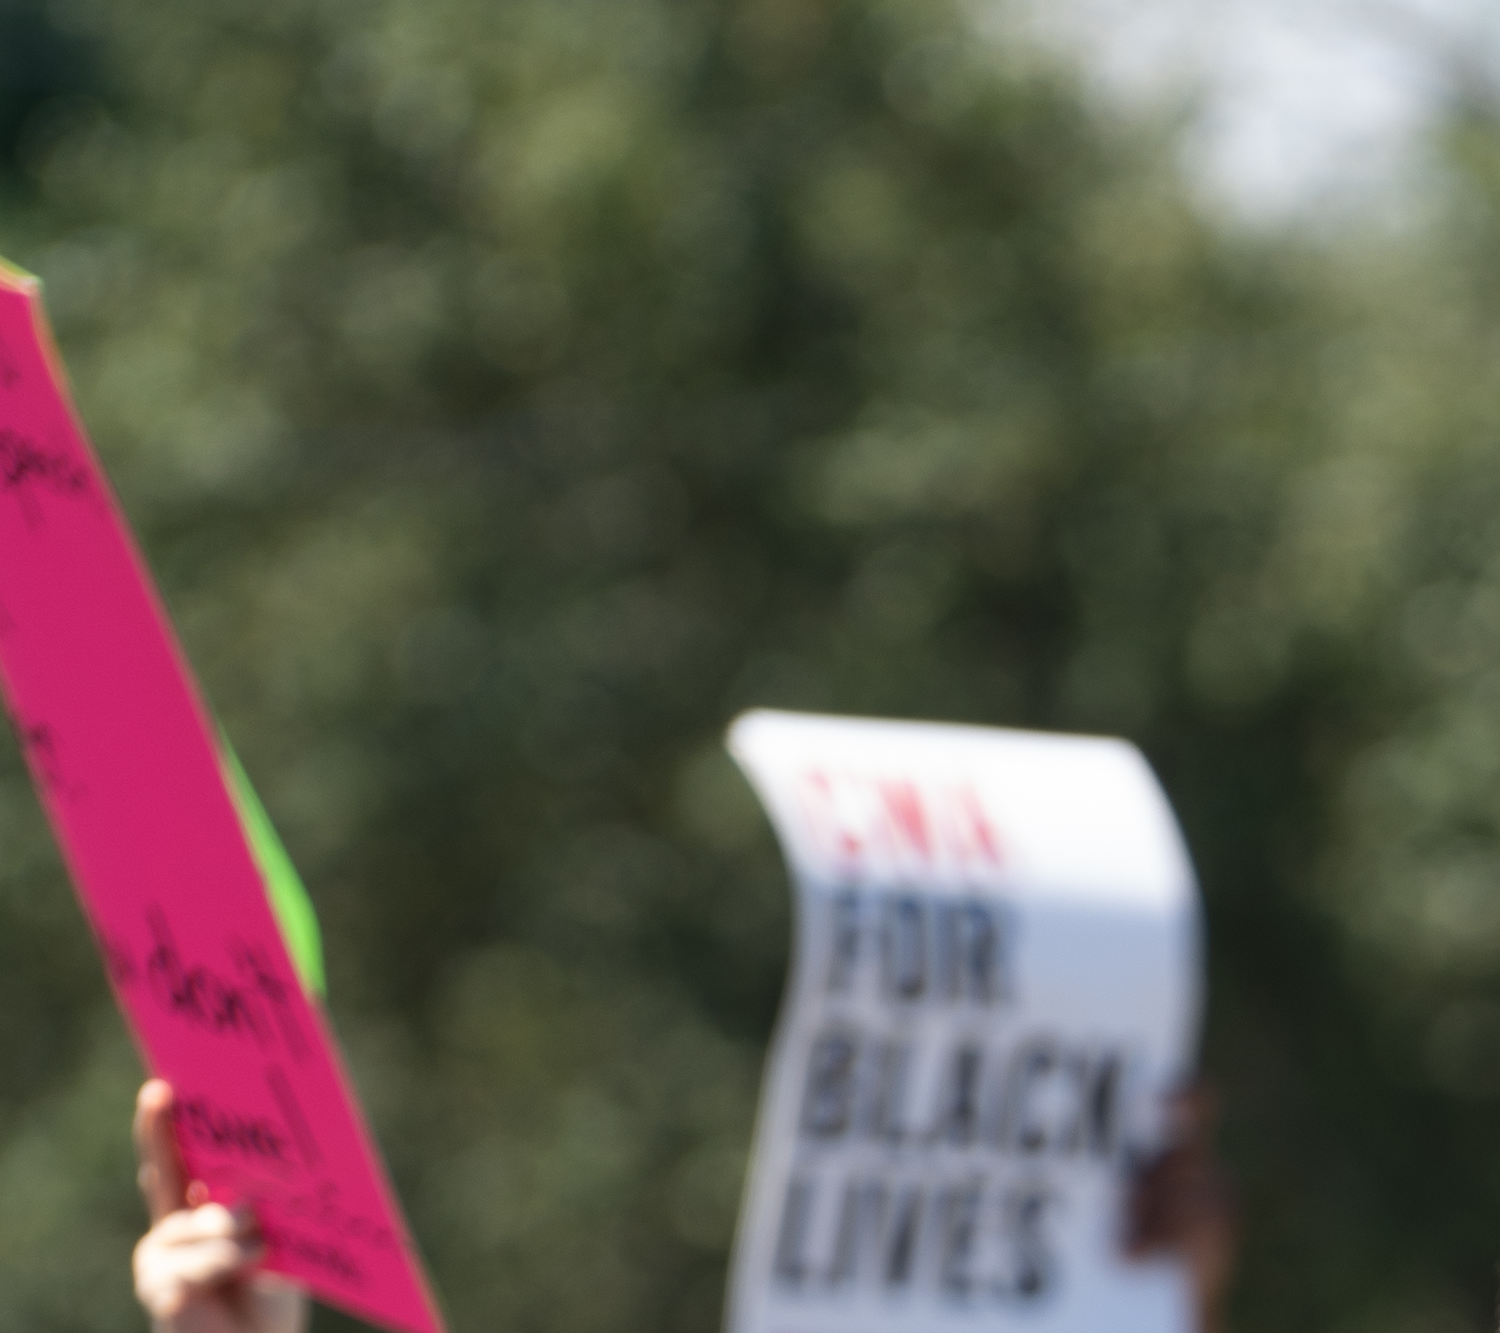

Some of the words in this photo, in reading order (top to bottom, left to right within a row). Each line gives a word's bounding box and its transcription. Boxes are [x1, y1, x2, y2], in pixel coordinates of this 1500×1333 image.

[824, 885, 1014, 1004] FOR
[798, 1026, 1136, 1160] BLACK
[771, 1172, 1066, 1306] LIVES
